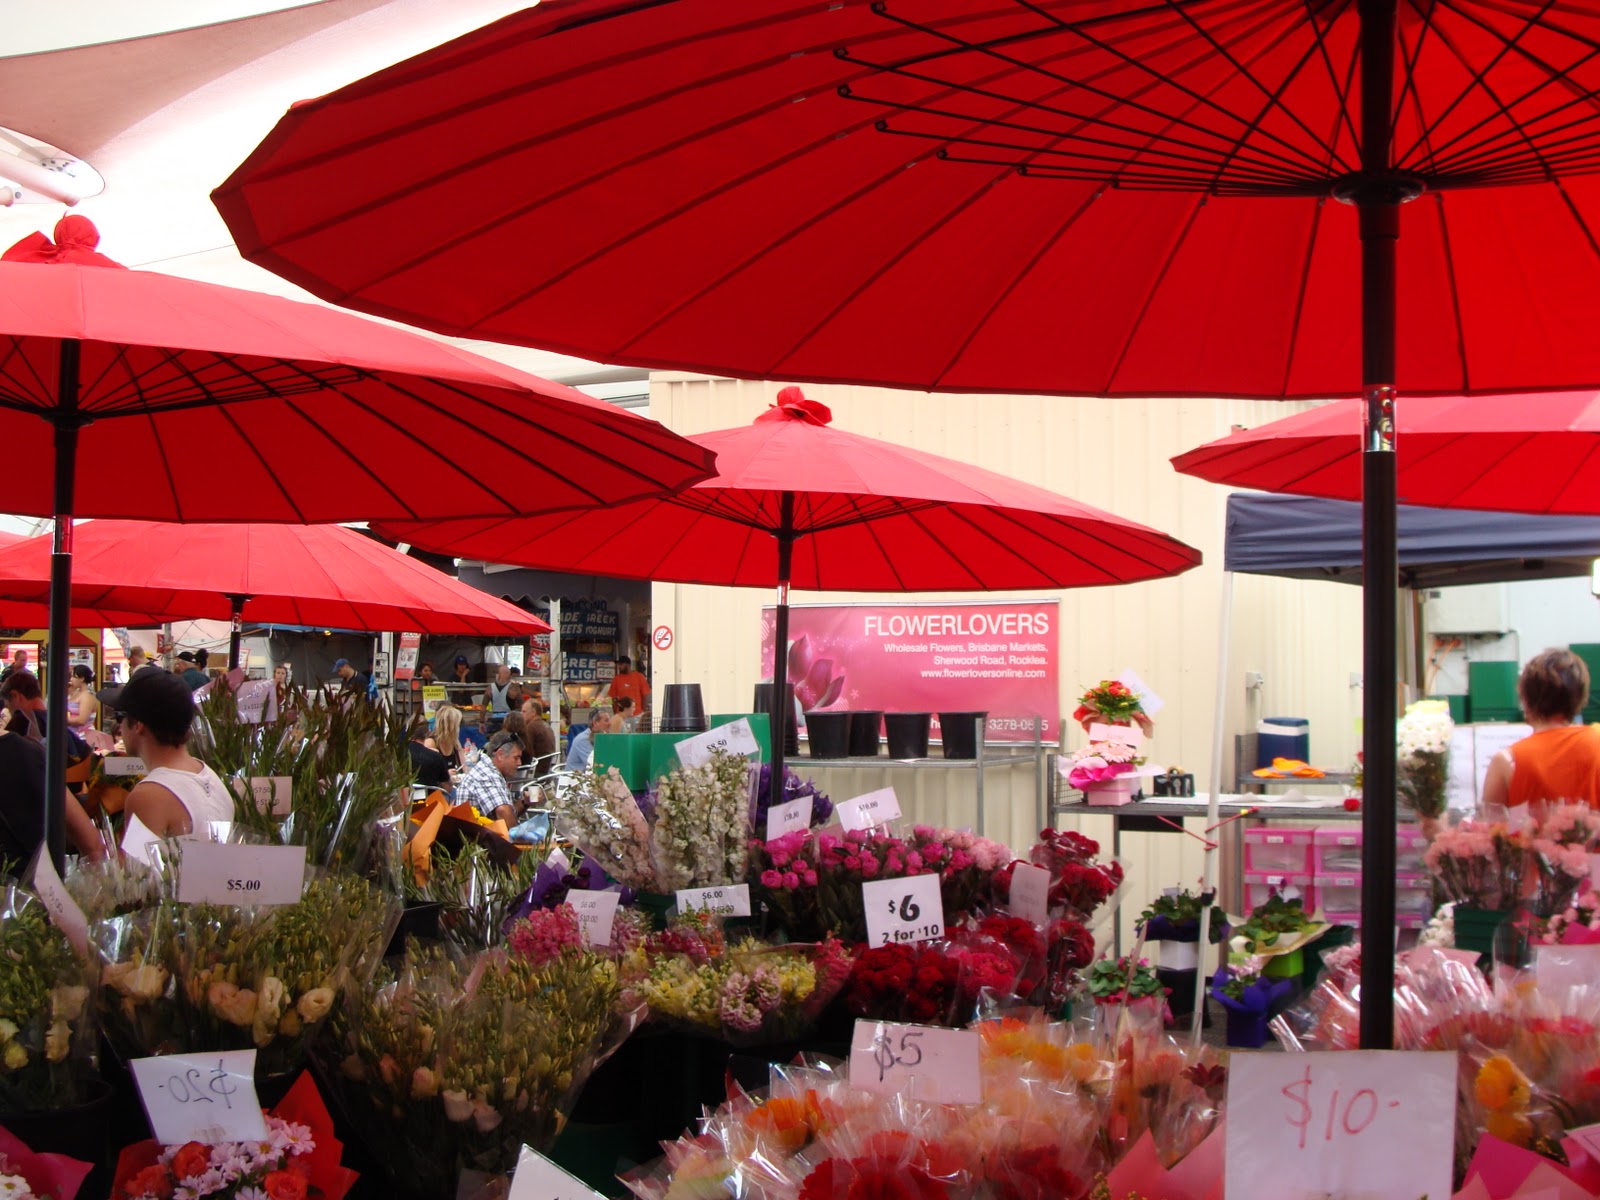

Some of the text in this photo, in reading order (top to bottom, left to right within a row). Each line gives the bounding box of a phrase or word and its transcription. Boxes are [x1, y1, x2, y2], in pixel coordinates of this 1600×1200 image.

[560, 624, 583, 634] EETS
[864, 612, 1050, 637] FLOWERLOVERS
[585, 625, 617, 636] YOGHURT
[884, 642, 1048, 653] Wholesale Flowers, Brisbane Markets,
[934, 655, 1048, 666] Sherwood Road, Rocklea.
[920, 668, 1046, 678] www.flowerloversonline.com
[989, 719, 1049, 731] 3278-065
[227, 879, 261, 891] $5.00
[702, 890, 723, 900] $6.00
[888, 894, 921, 922] $6
[882, 932, 890, 943] 2
[894, 929, 915, 941] for
[873, 1028, 924, 1083] $5
